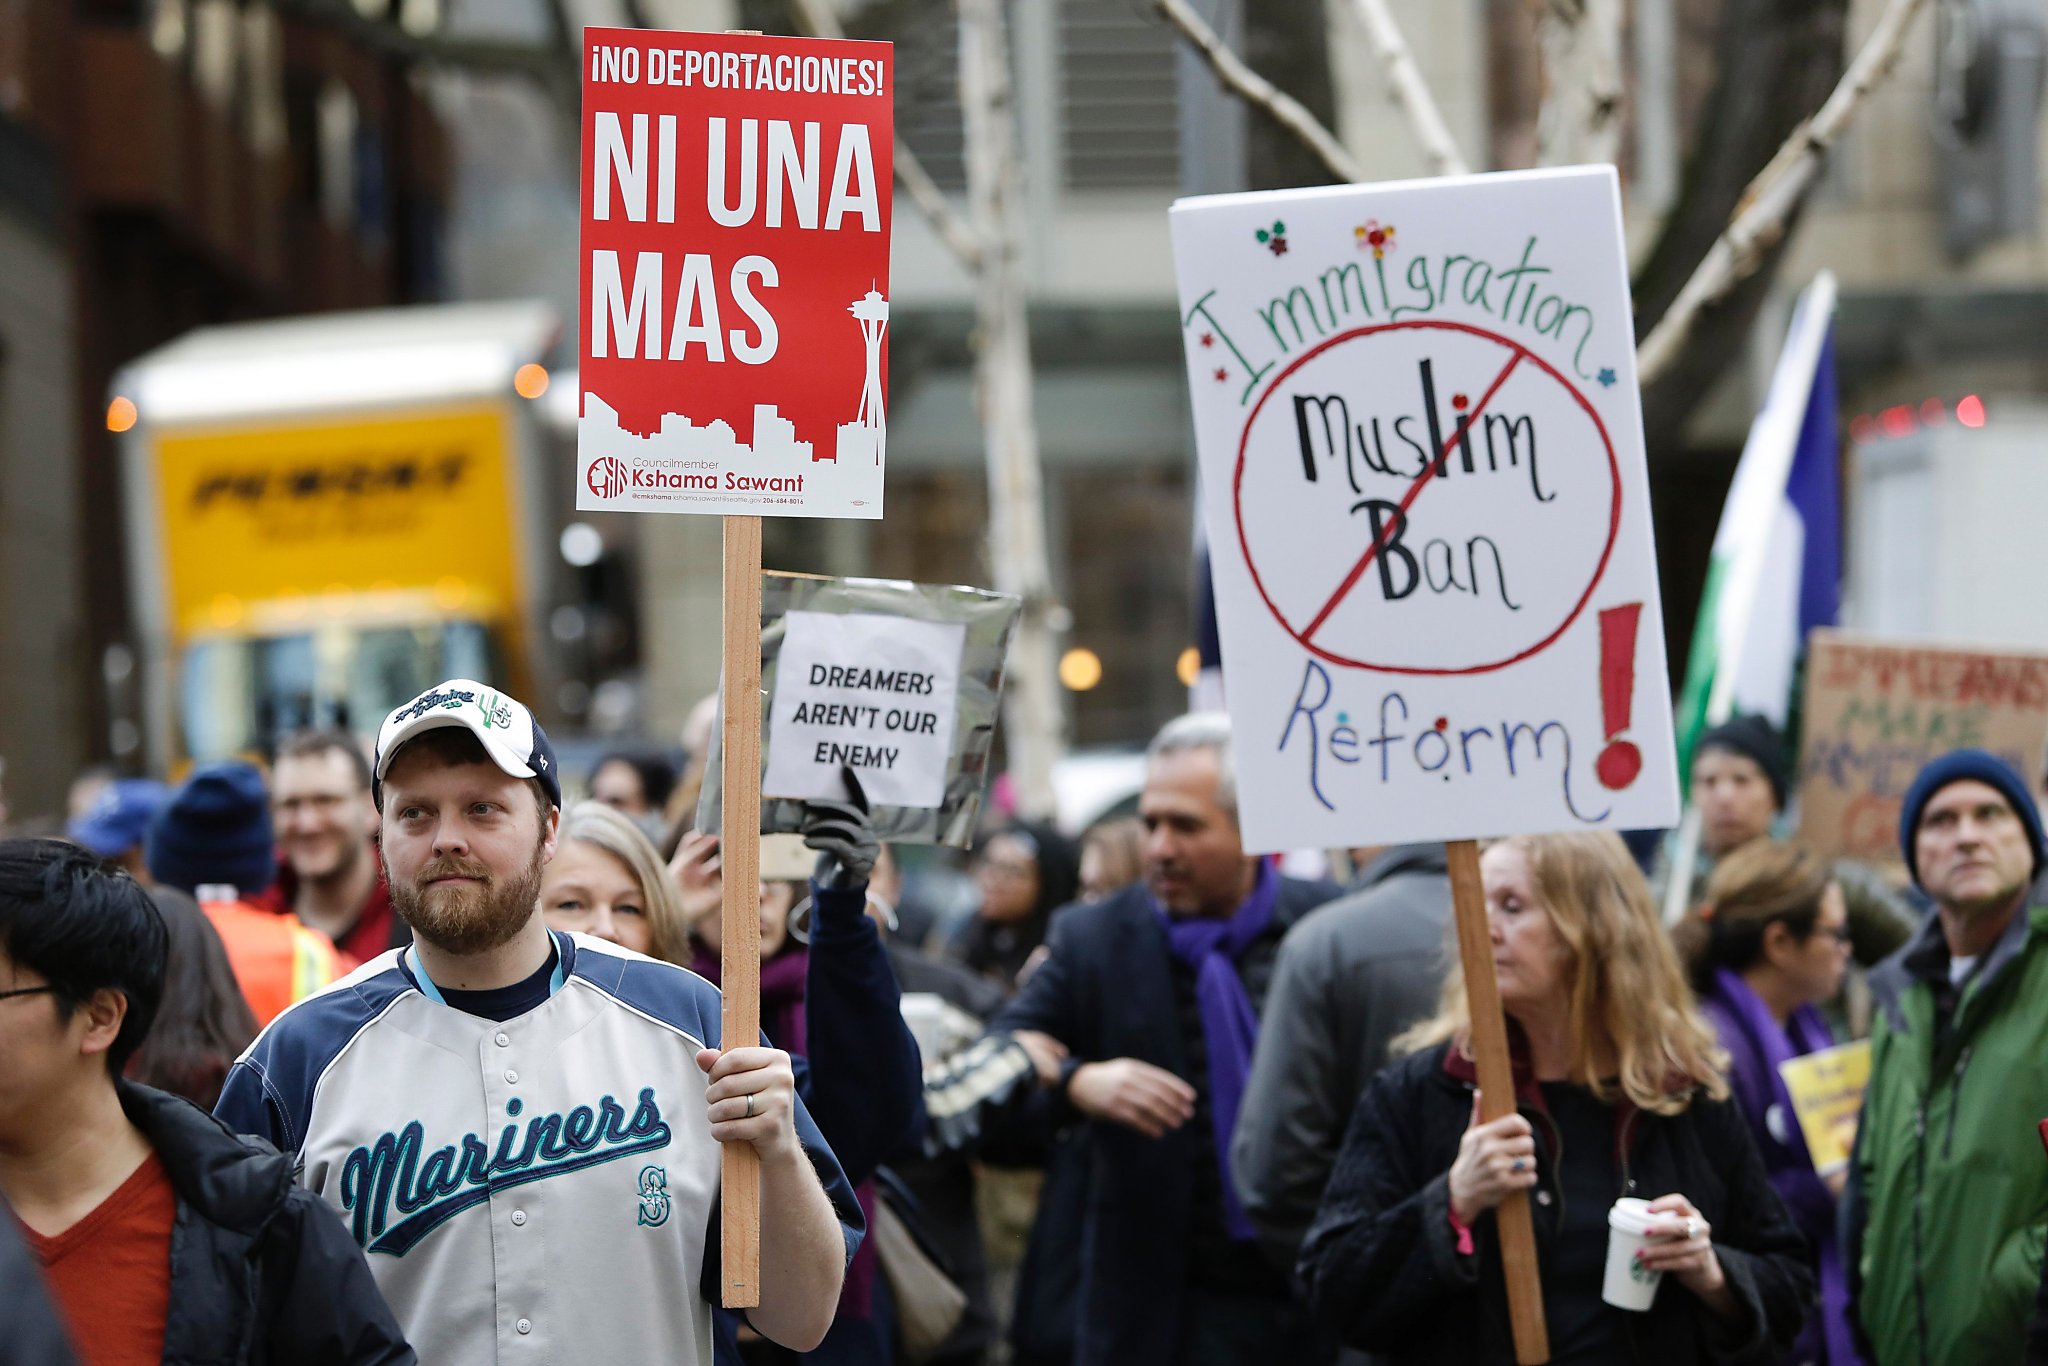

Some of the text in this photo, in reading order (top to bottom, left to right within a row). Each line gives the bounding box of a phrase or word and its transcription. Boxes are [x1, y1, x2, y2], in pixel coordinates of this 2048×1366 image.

[591, 45, 884, 96] ¡NO DEPORTACIONES!
[593, 111, 881, 232] NI UNA
[591, 249, 779, 365] MAS
[1185, 236, 1594, 406] Immigration
[632, 457, 719, 470] Councilmember
[1292, 358, 1557, 501] Muslim
[632, 469, 804, 492] Kshama Sawant
[1349, 499, 1522, 610] Ban
[792, 702, 937, 735] AREN'T OUR
[809, 665, 935, 695] DREAMERS
[814, 742, 900, 769] ENEMY
[340, 1085, 672, 1249] Mariners
